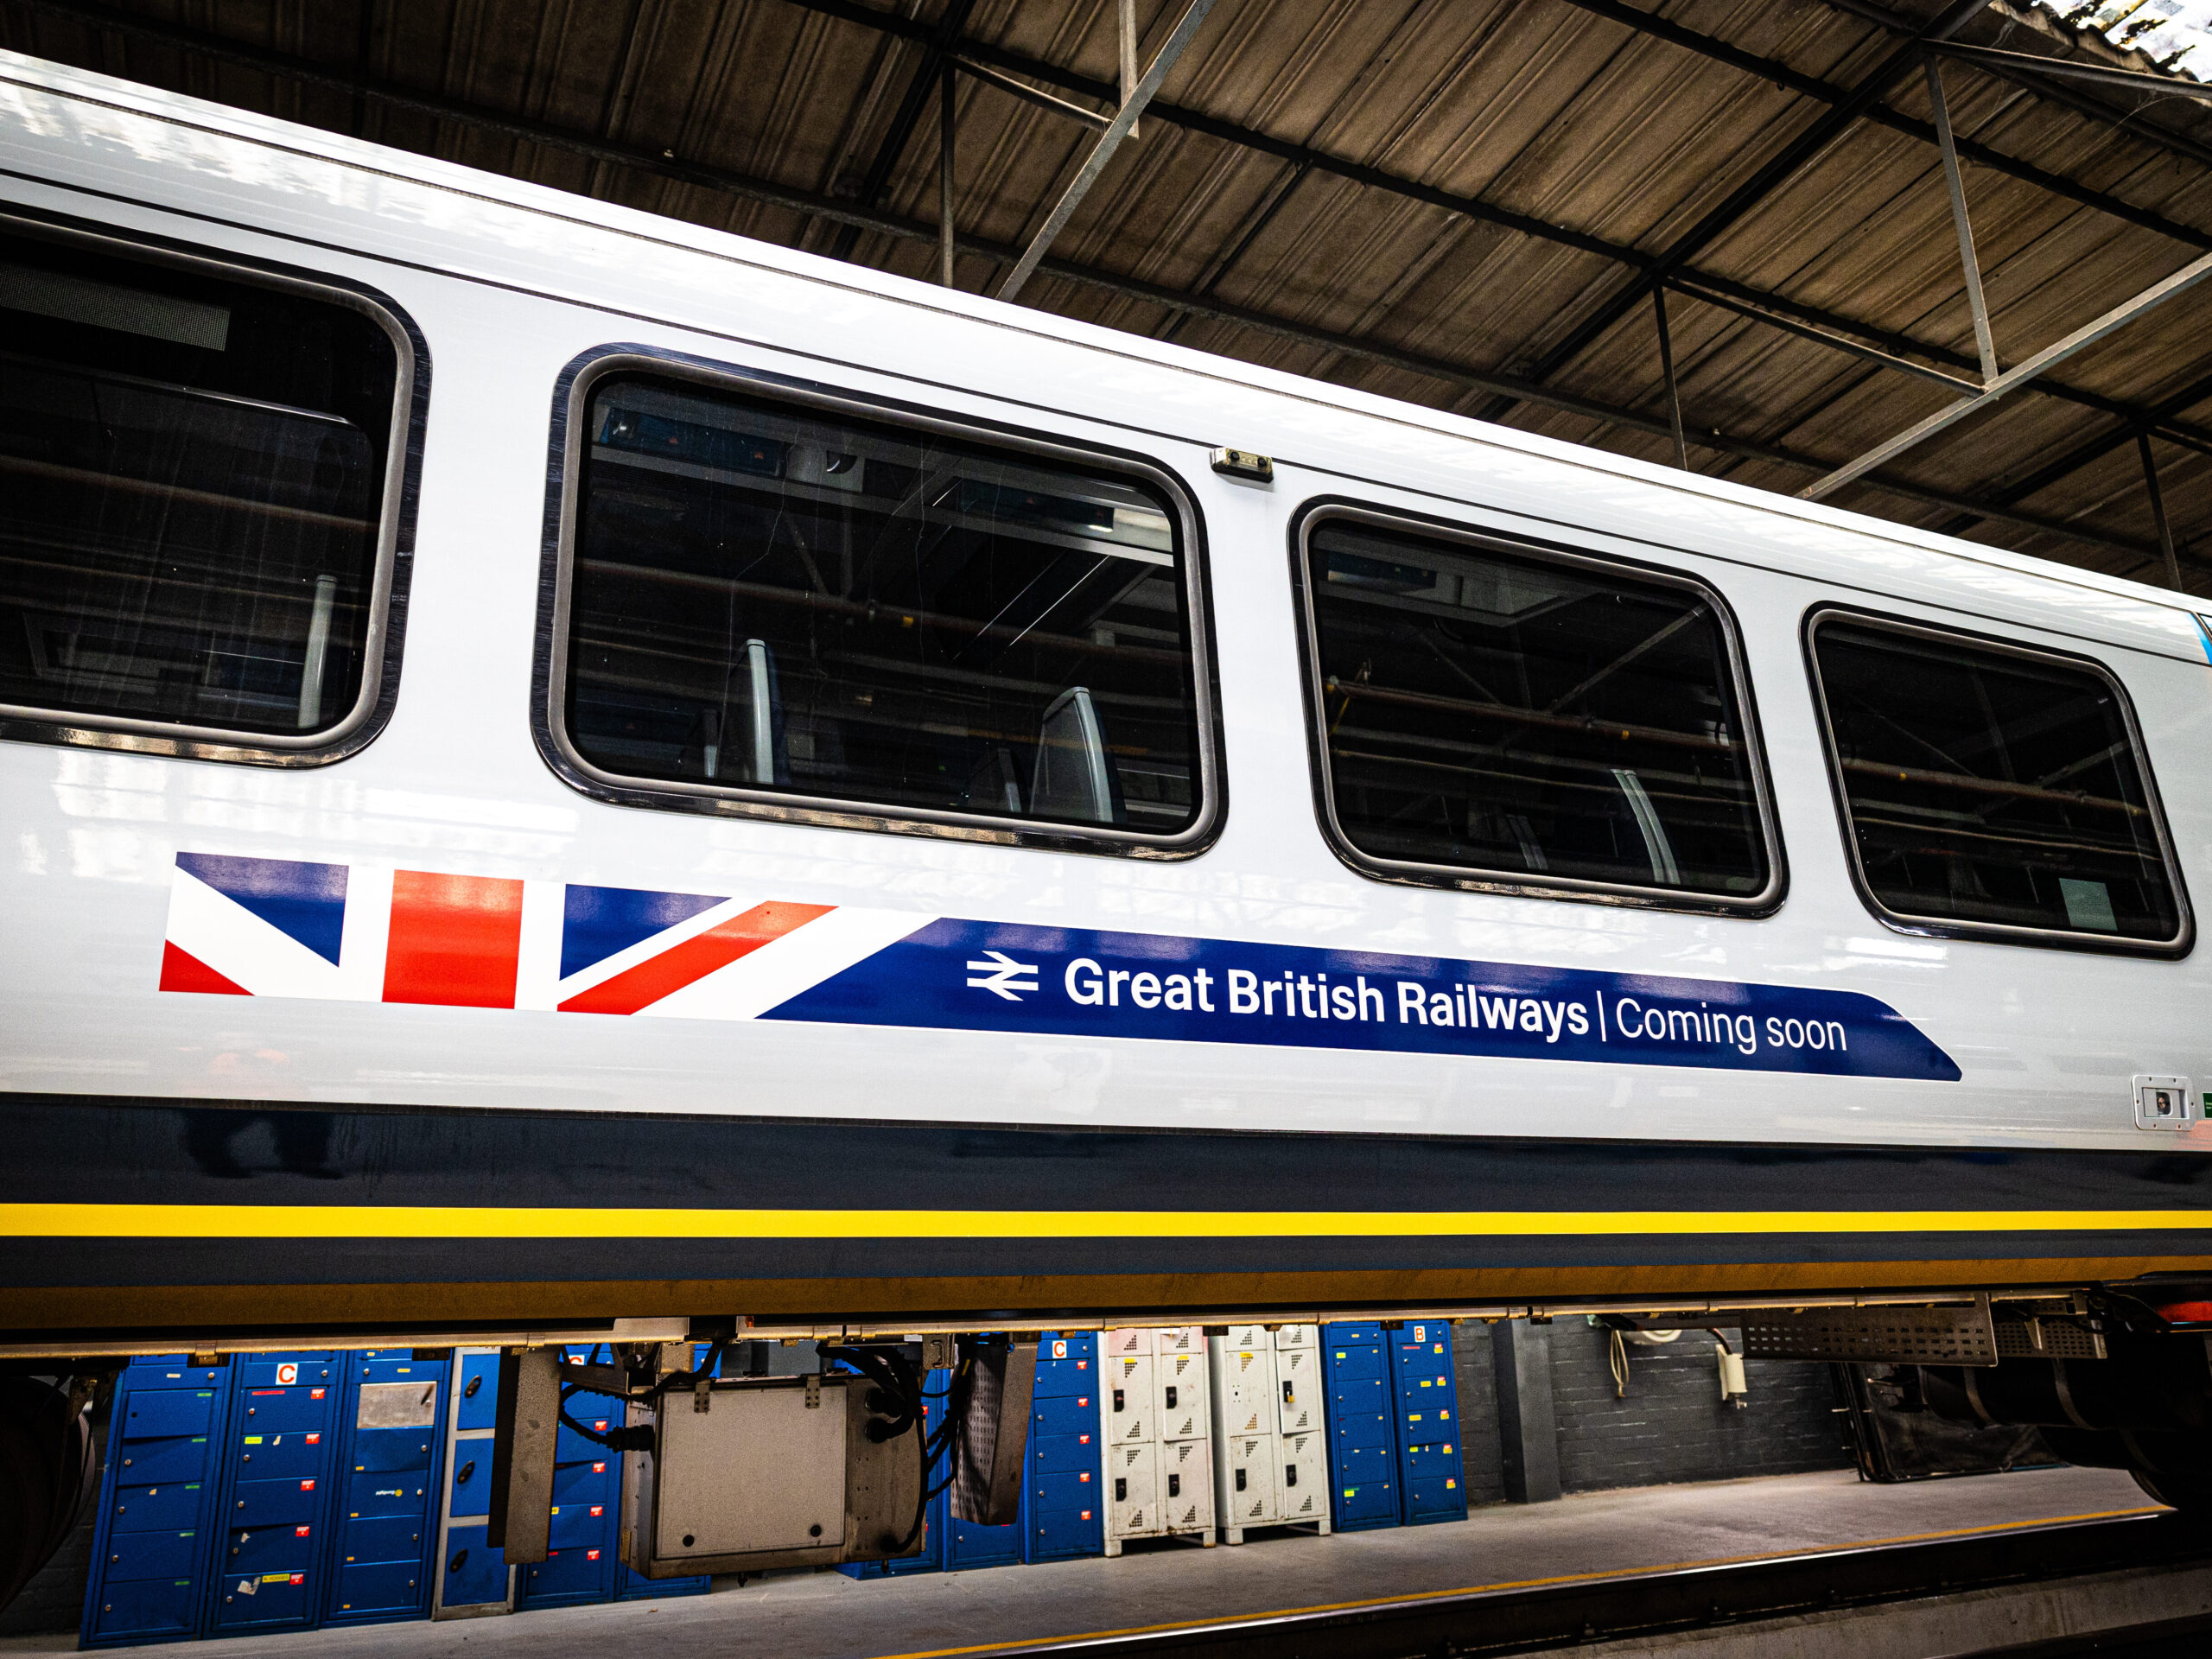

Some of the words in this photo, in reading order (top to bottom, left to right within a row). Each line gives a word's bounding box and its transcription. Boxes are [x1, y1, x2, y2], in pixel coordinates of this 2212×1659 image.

[1064, 957, 1215, 1013] Great
[1227, 969, 1385, 1022] British
[1396, 981, 1589, 1043] Railways
[1616, 997, 1757, 1055] Coming
[1766, 1016, 1847, 1051] soon
[1415, 1327, 1424, 1341] B
[1053, 1342, 1065, 1357] C
[278, 1364, 296, 1383] C
